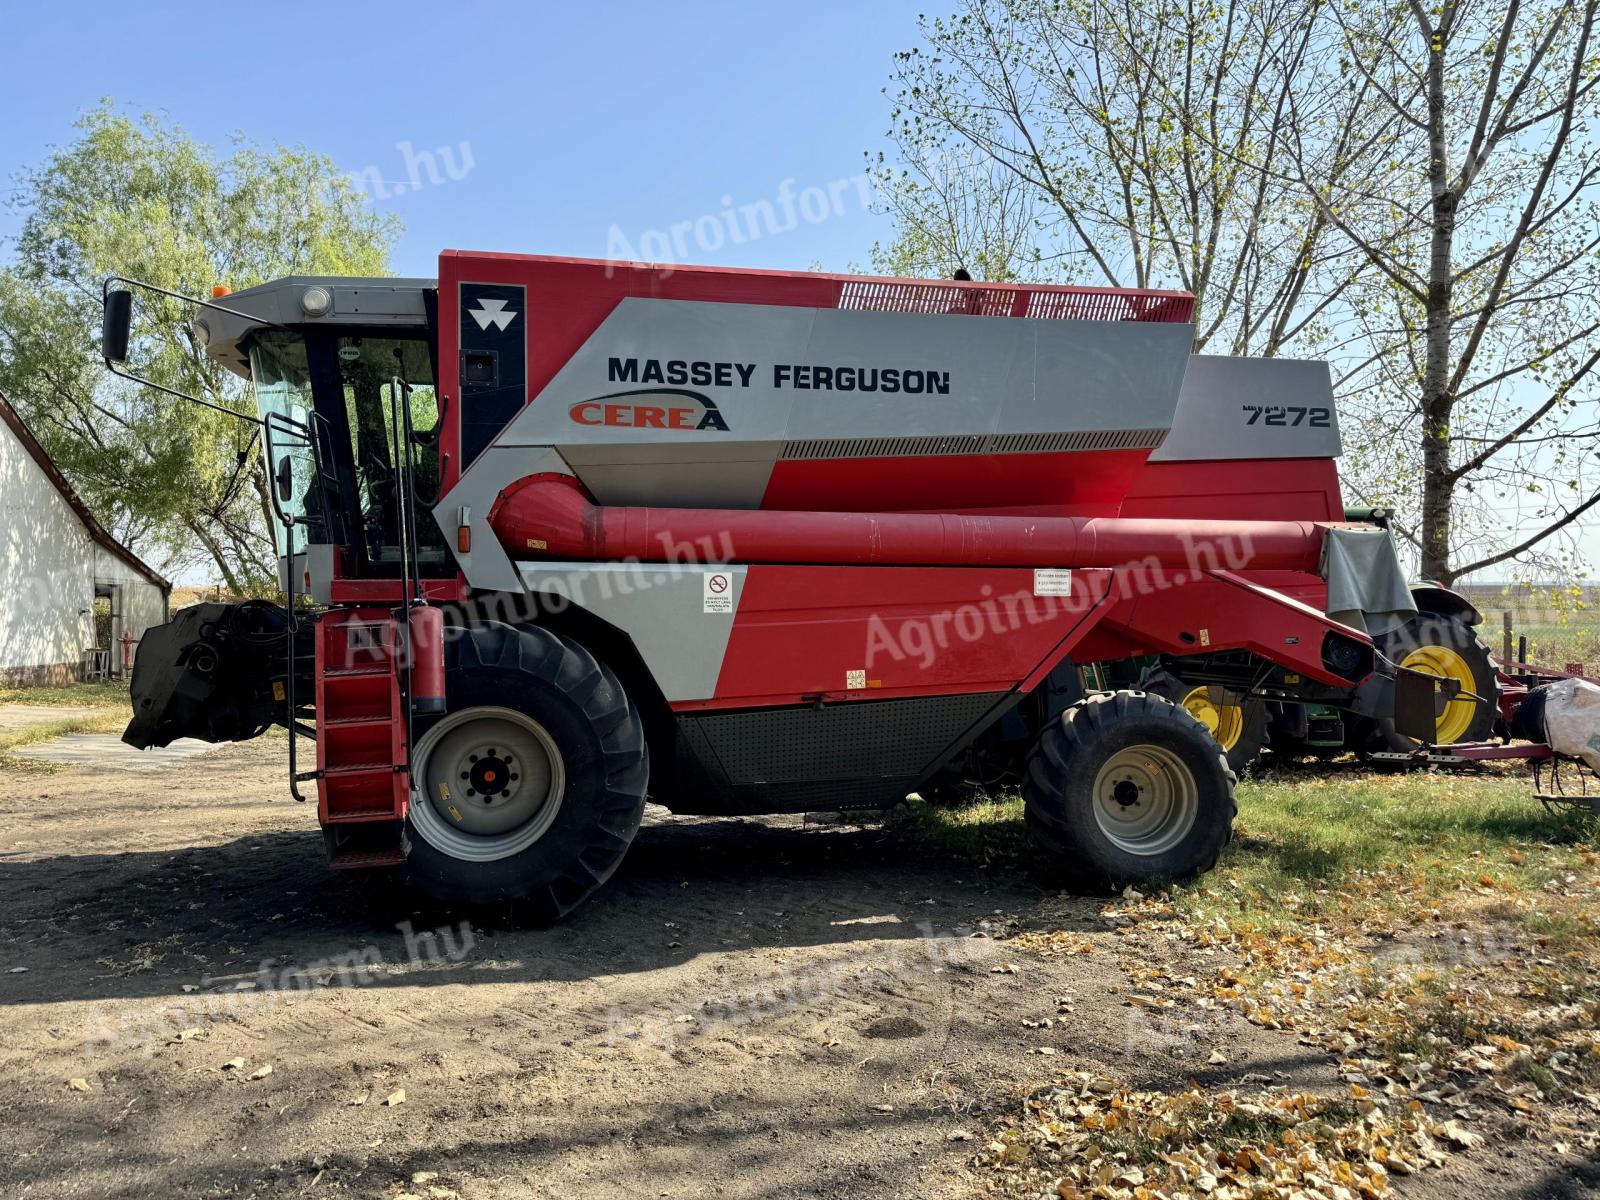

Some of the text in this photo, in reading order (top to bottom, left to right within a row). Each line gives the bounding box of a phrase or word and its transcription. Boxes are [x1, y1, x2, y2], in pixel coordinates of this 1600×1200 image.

[608, 357, 950, 395] MASSEY FERGUSON
[568, 402, 731, 432] CEREA
[1242, 405, 1331, 428] 7272
